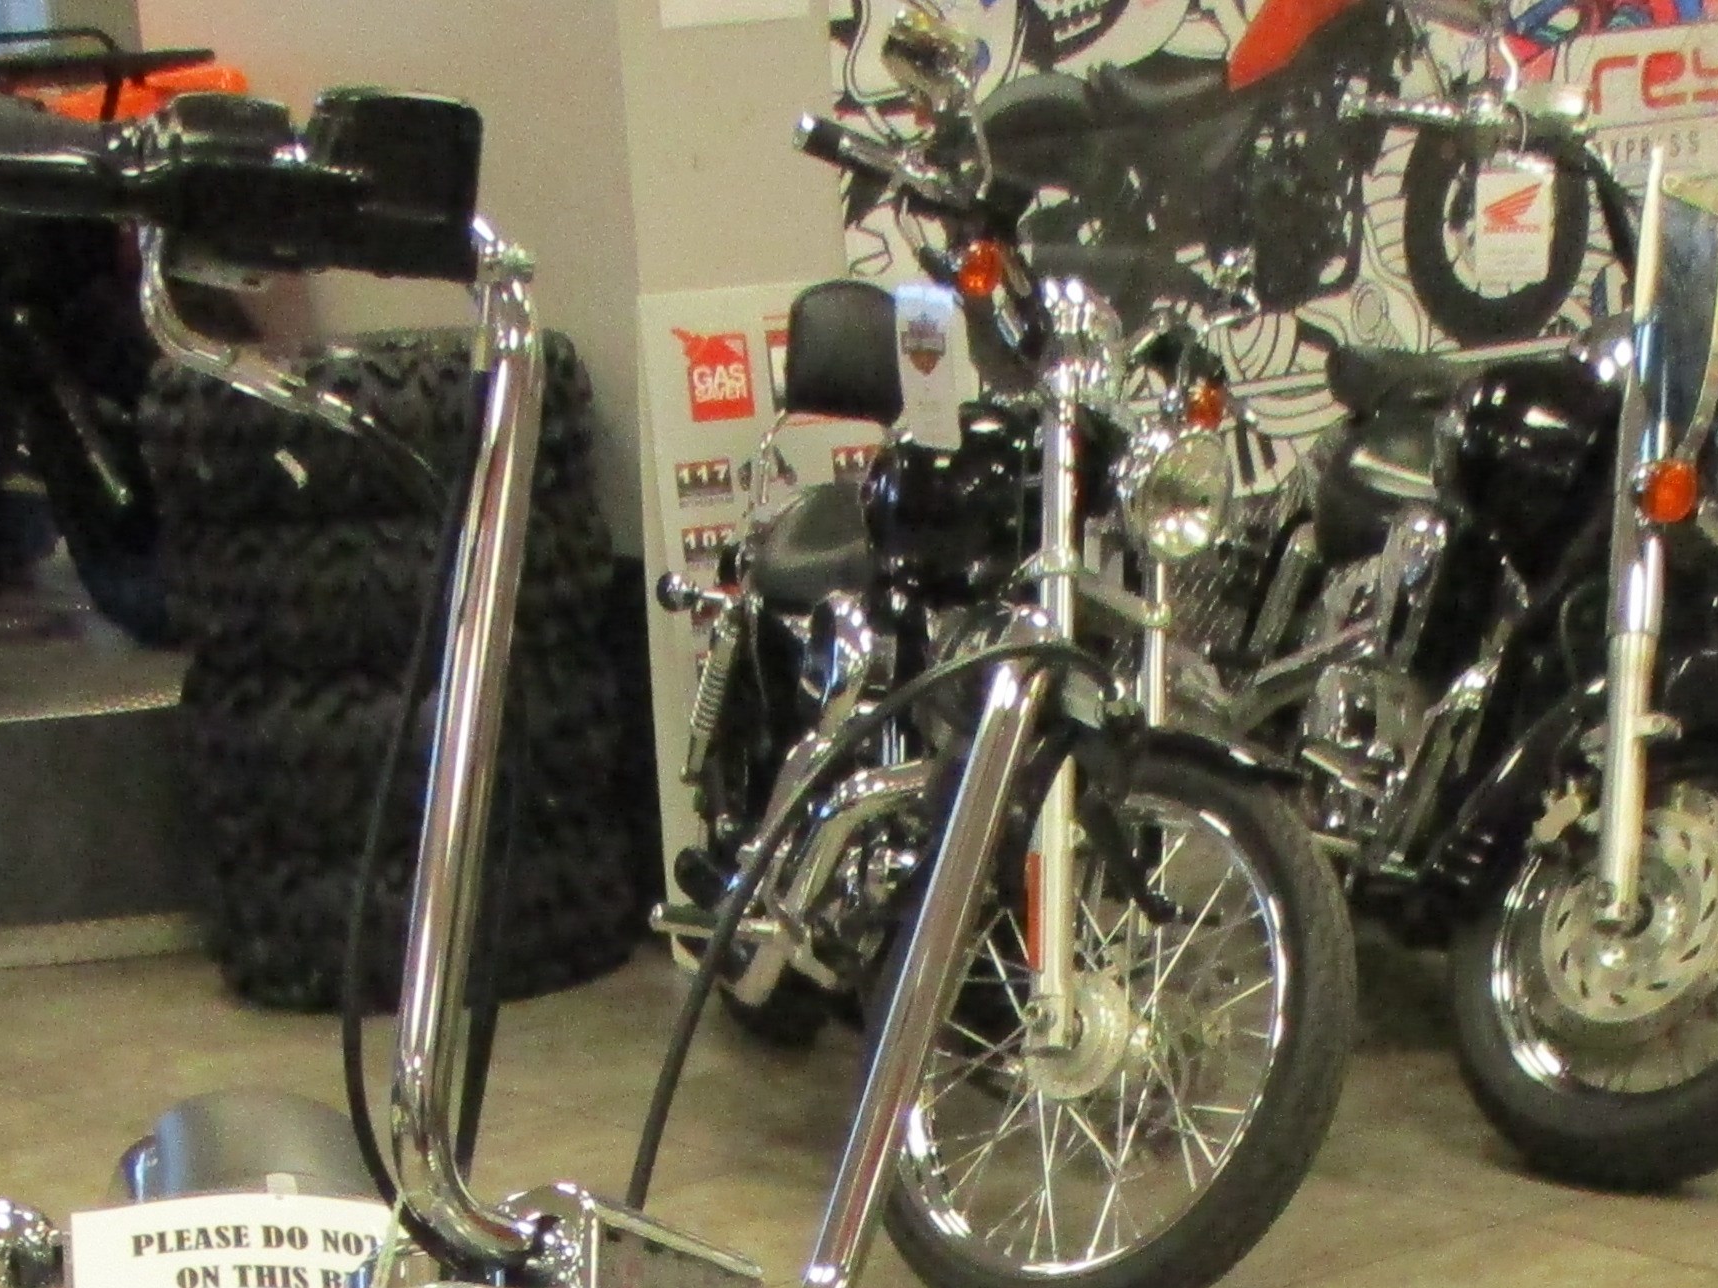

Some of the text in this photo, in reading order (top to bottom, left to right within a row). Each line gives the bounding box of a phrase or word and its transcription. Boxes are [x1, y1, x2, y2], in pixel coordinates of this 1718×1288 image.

[692, 363, 746, 389] GAS
[678, 464, 729, 485] 117
[132, 1225, 250, 1257] PLEASE
[262, 1225, 309, 1250] DO
